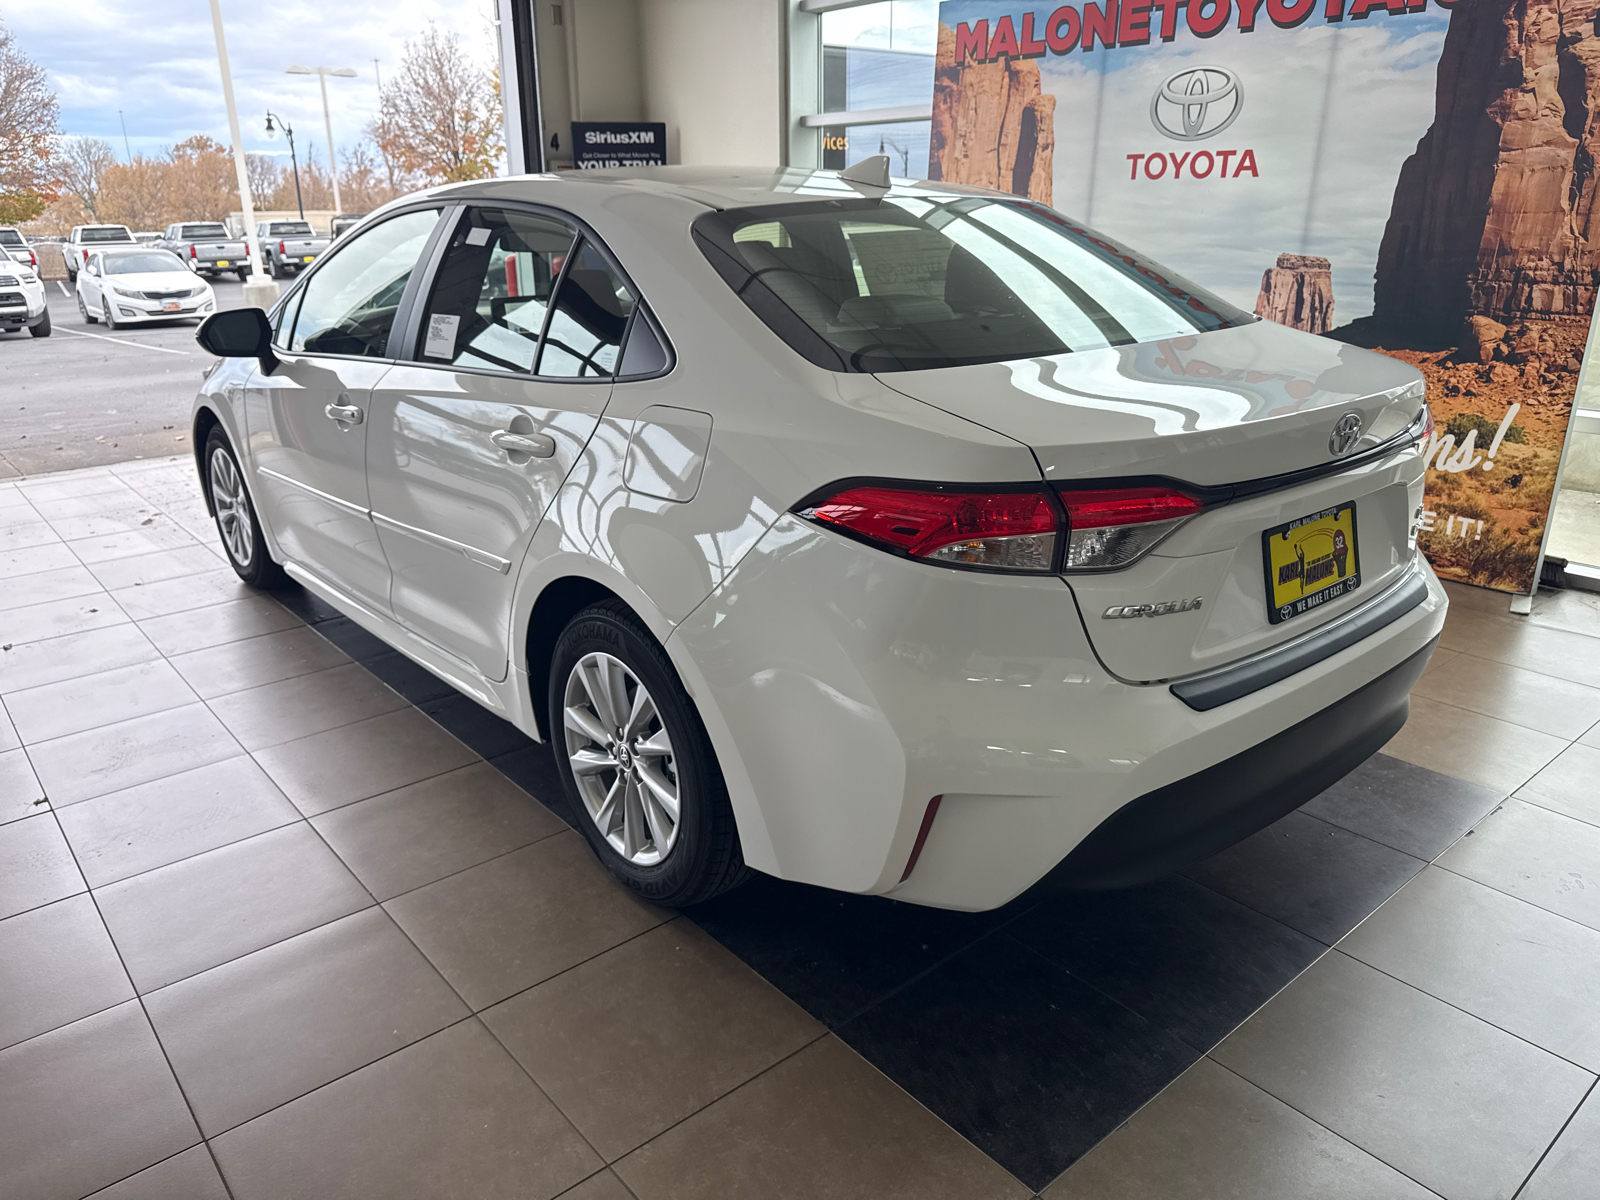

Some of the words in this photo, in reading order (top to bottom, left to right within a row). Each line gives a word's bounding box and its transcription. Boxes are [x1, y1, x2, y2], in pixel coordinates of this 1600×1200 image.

[550, 132, 560, 151] 4
[585, 131, 655, 144] SiriusXM
[823, 132, 849, 150] vices
[577, 160, 620, 170] YOUR
[1126, 149, 1259, 181] TOYOTA
[1422, 402, 1521, 474] ns!
[1302, 512, 1321, 525] MALONE
[1419, 510, 1437, 532] E
[1446, 515, 1484, 541] IT!
[1334, 535, 1344, 549] 32
[1278, 560, 1301, 585] KARL
[1305, 558, 1335, 586] MALONE
[1101, 596, 1203, 619] COROLLA
[1296, 600, 1306, 612] WE
[1307, 593, 1323, 608] MAKE
[1323, 591, 1330, 602] IT
[1330, 584, 1343, 600] EASY
[566, 623, 620, 648] YOKOHAMA
